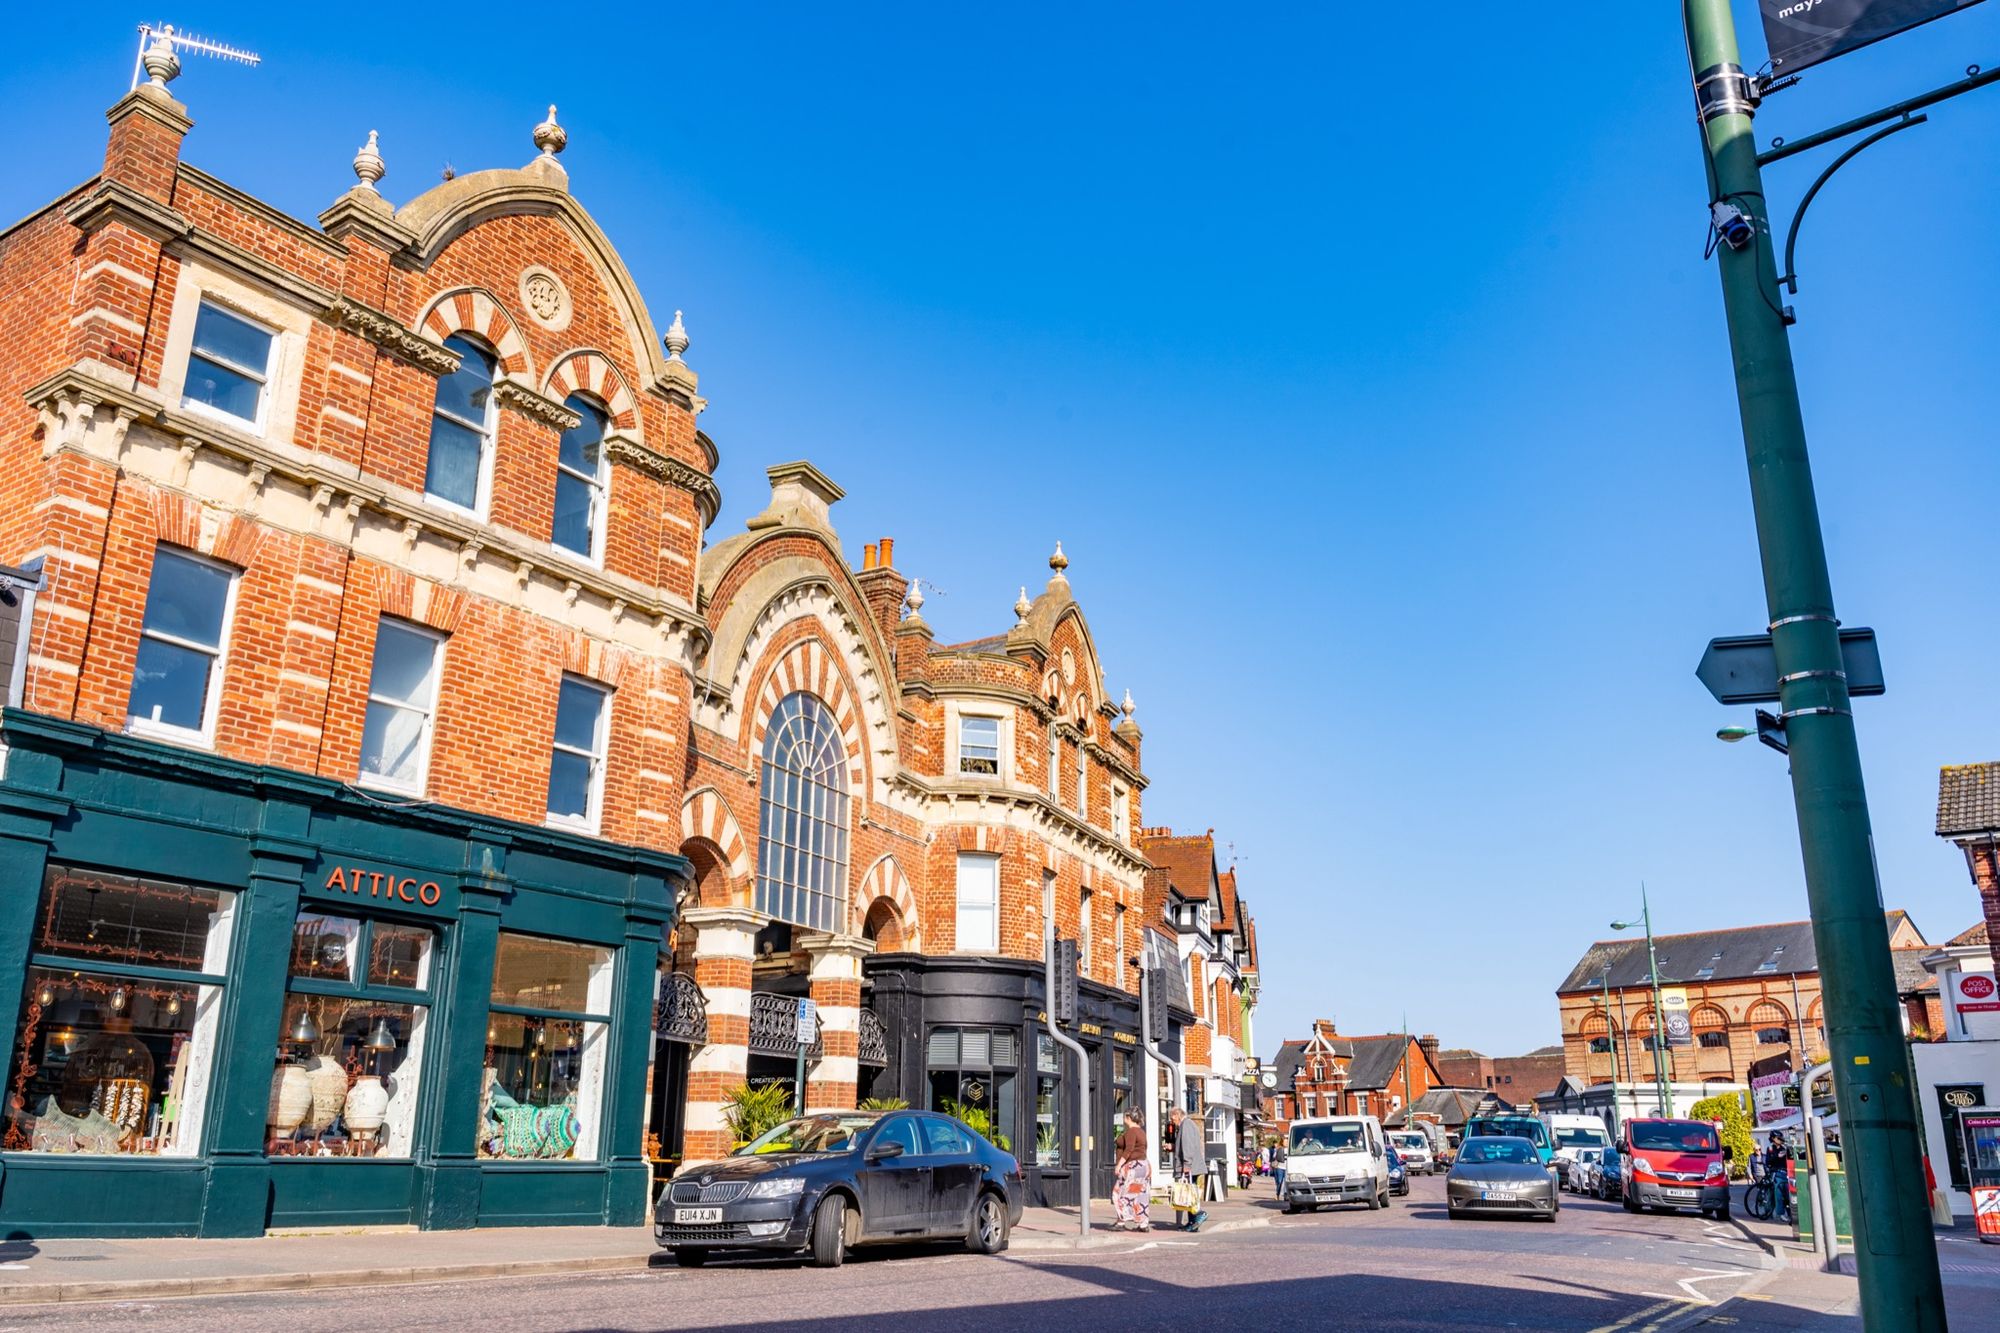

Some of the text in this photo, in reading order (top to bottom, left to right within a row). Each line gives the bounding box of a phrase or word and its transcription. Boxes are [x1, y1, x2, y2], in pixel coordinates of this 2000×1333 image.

[326, 867, 441, 905] ATTICO
[1945, 1092, 1968, 1101] CHEZ
[1954, 1098, 1973, 1106] FRED
[680, 1210, 717, 1220] EU14 XJN
